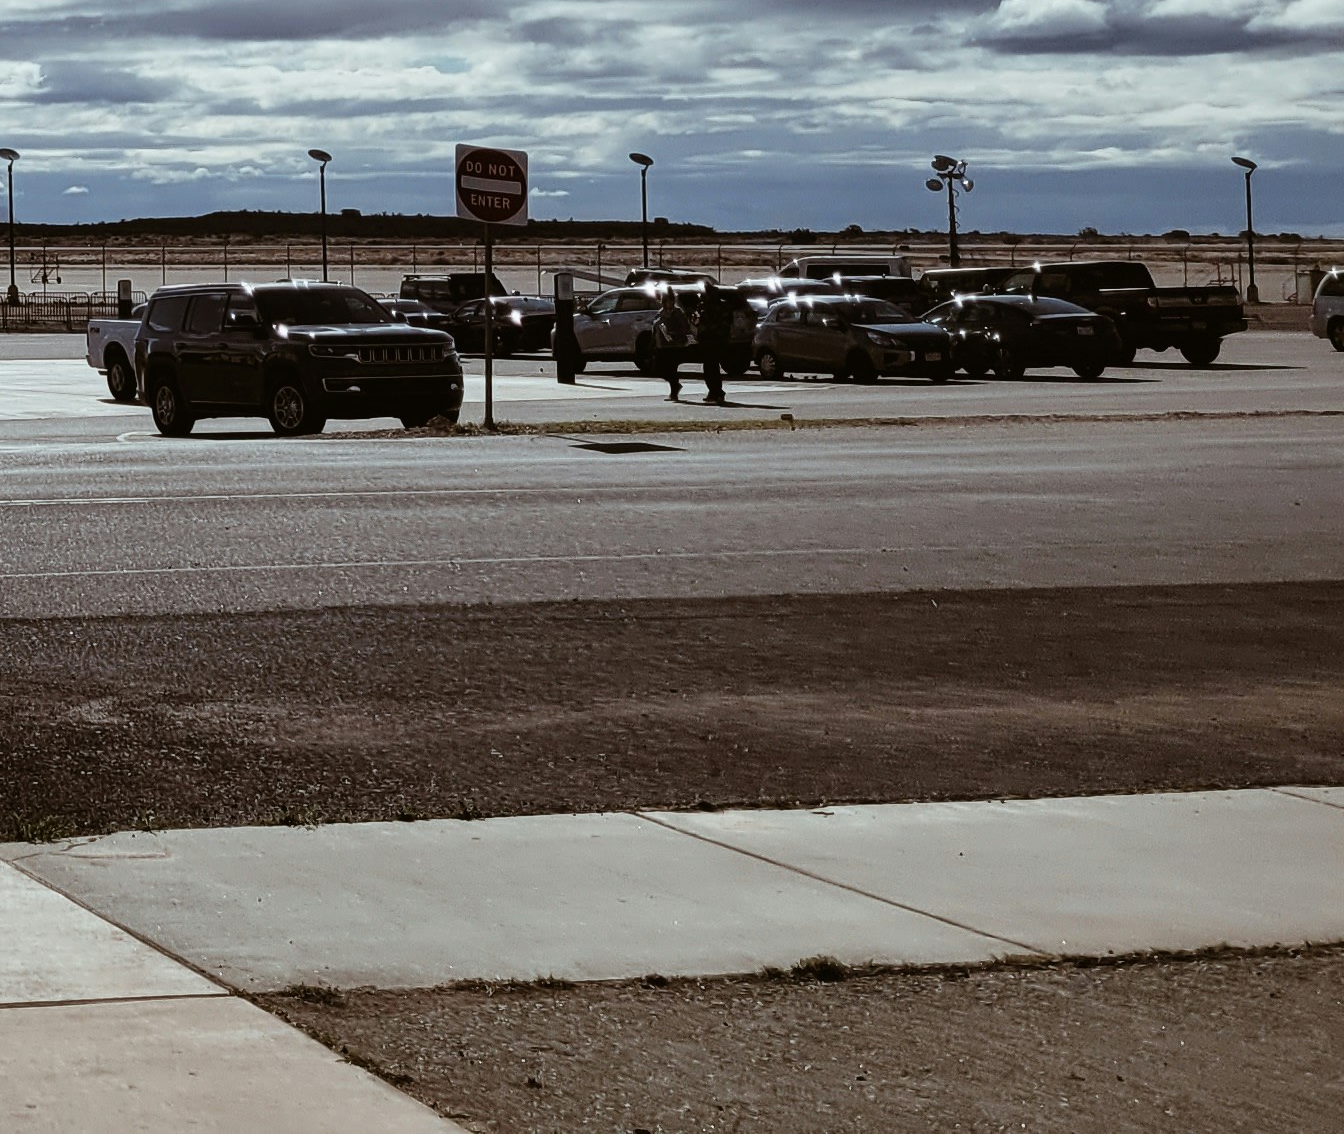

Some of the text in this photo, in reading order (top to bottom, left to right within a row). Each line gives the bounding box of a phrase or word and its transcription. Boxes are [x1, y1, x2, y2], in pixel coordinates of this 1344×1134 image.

[466, 161, 515, 177] DO NOT
[471, 194, 511, 209] ENTER
